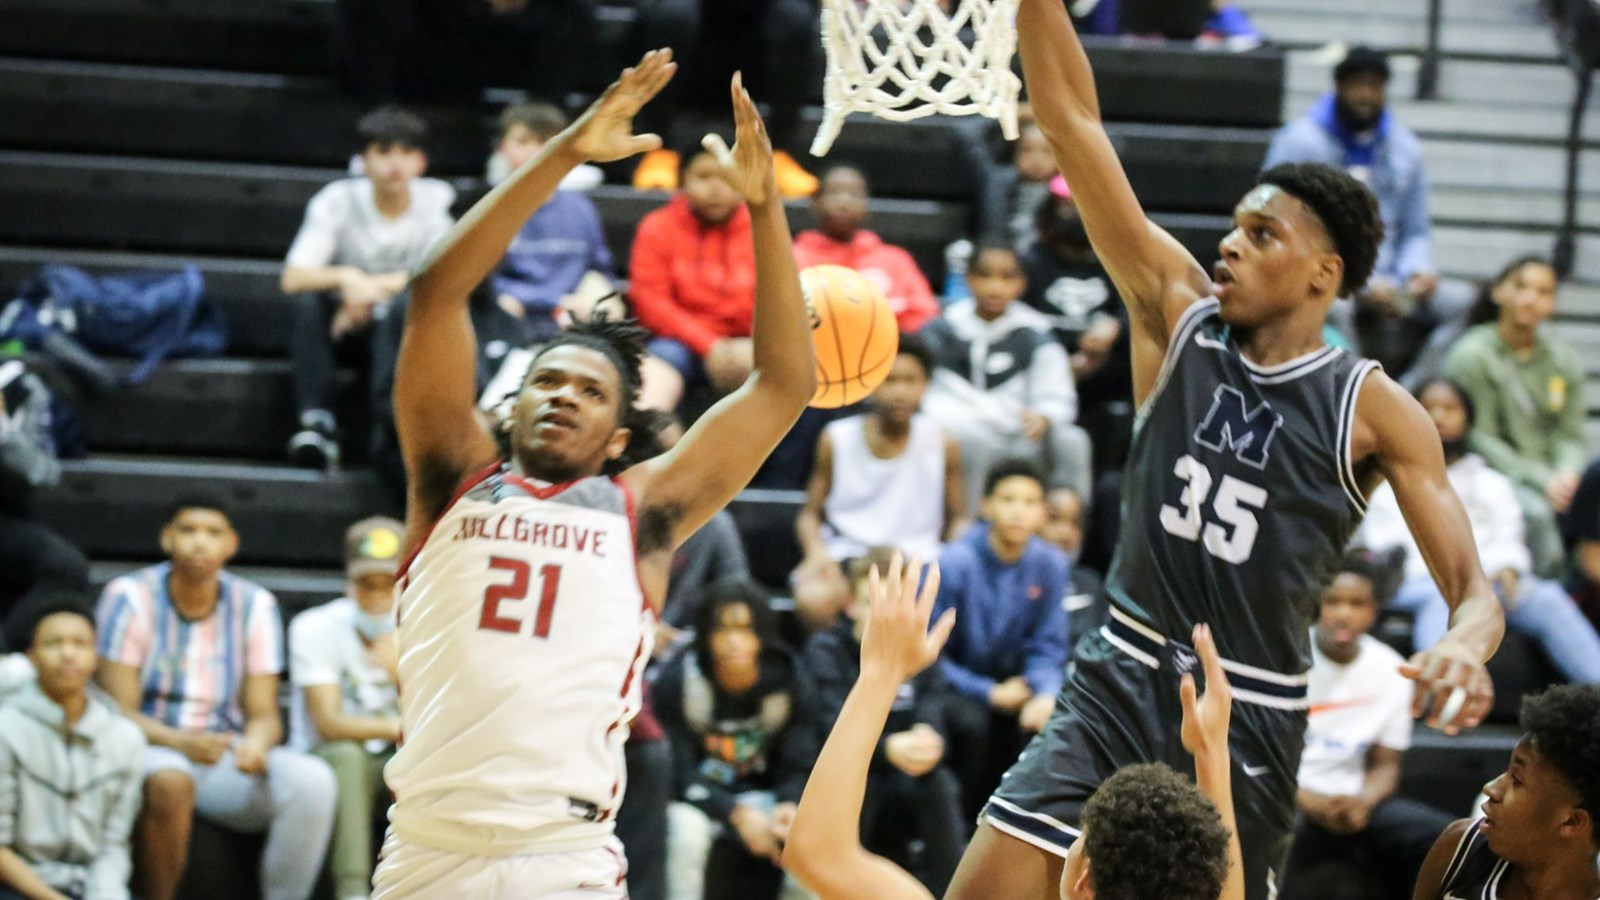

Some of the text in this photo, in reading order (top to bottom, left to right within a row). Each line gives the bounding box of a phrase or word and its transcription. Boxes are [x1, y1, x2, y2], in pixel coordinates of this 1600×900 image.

[1194, 383, 1283, 470] M
[1159, 454, 1268, 565] 35
[477, 555, 562, 639] 21
